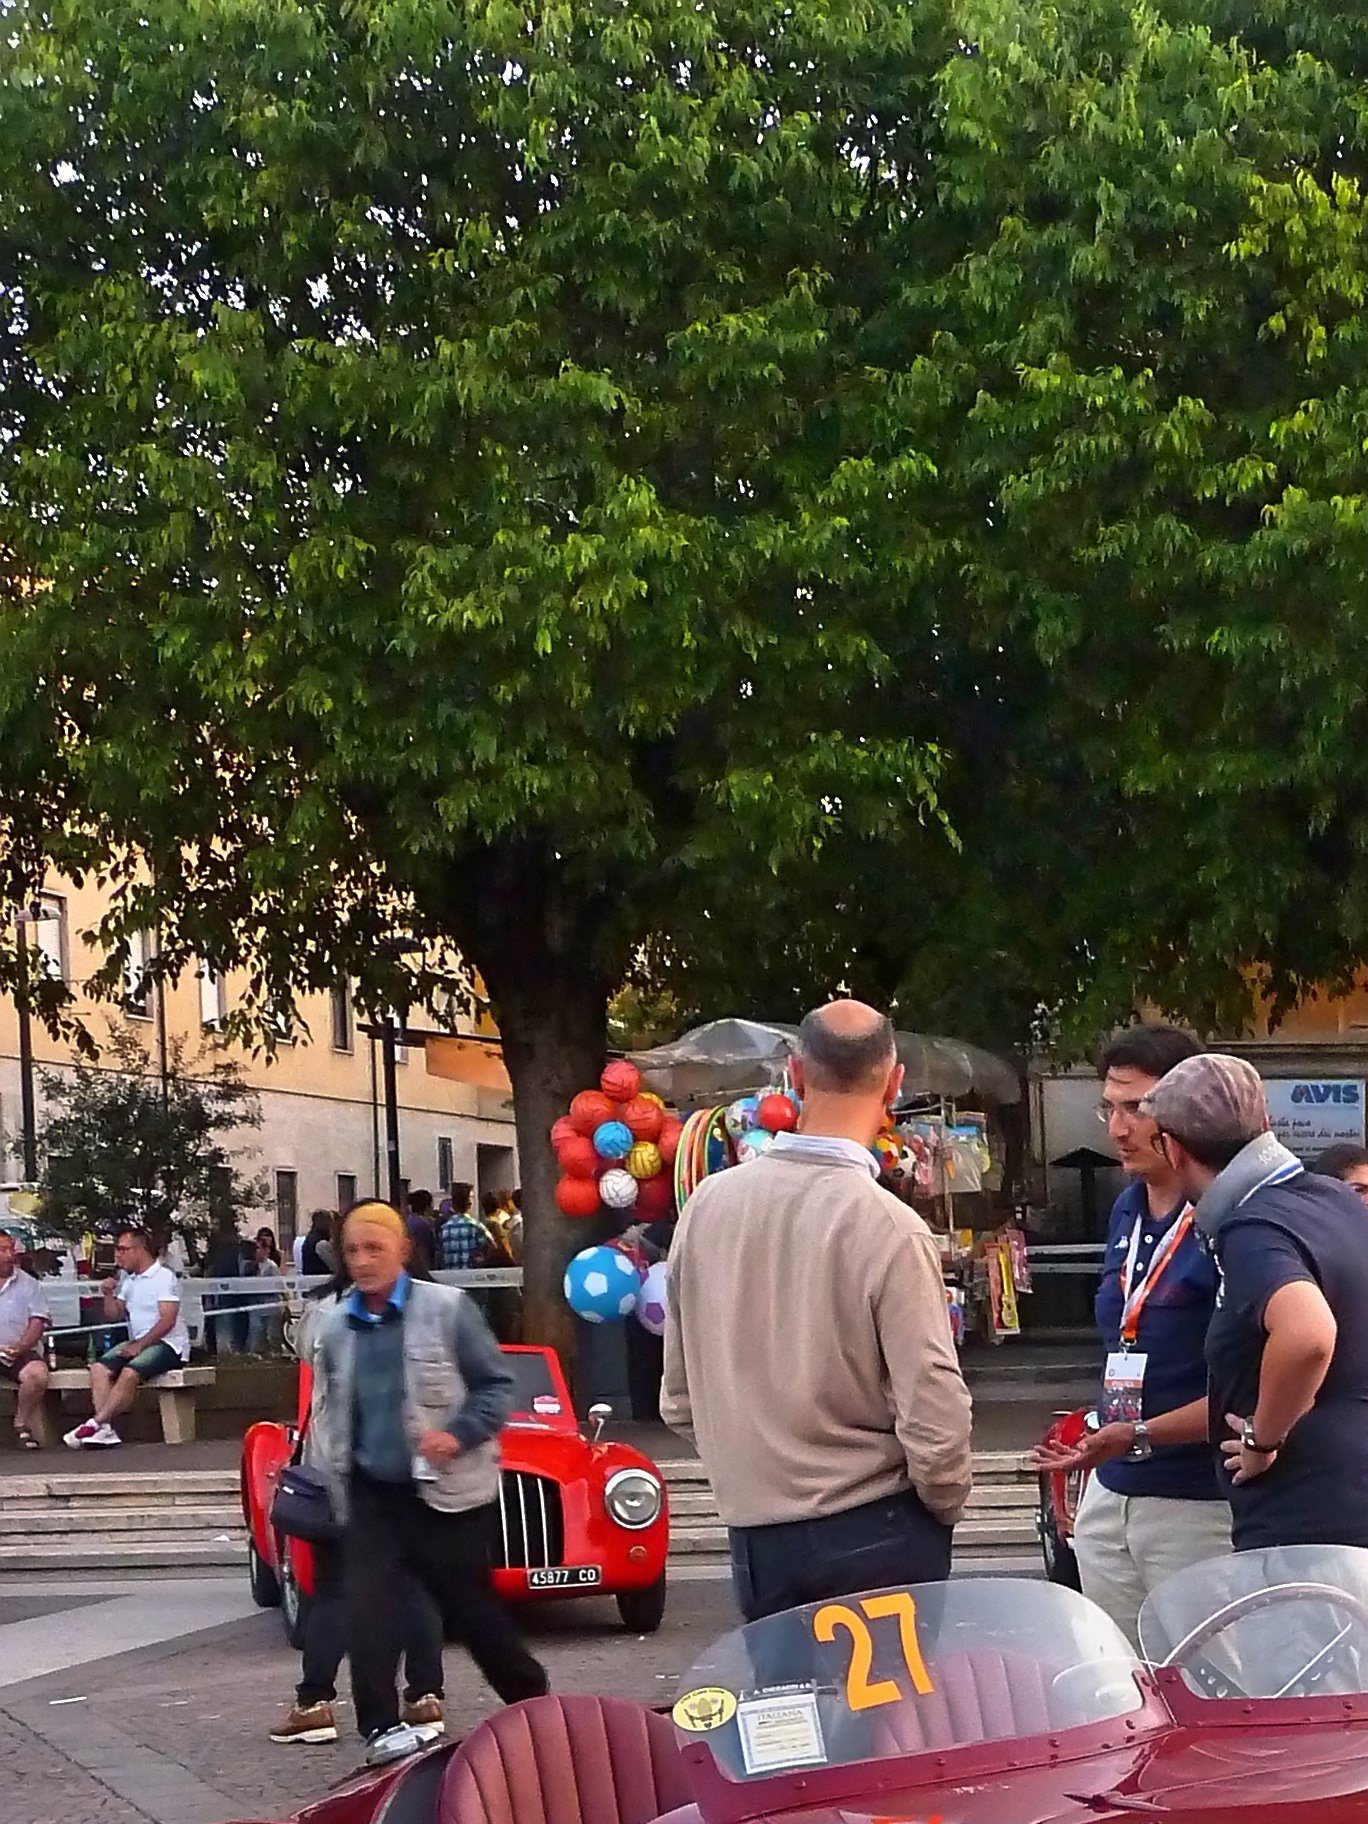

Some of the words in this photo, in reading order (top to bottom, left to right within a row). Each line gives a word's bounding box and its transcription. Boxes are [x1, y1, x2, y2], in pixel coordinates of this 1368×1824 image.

[1291, 1084, 1360, 1103] AVIS
[532, 1571, 568, 1585] 45877
[579, 1569, 596, 1581] CO
[814, 1592, 934, 1711] 27
